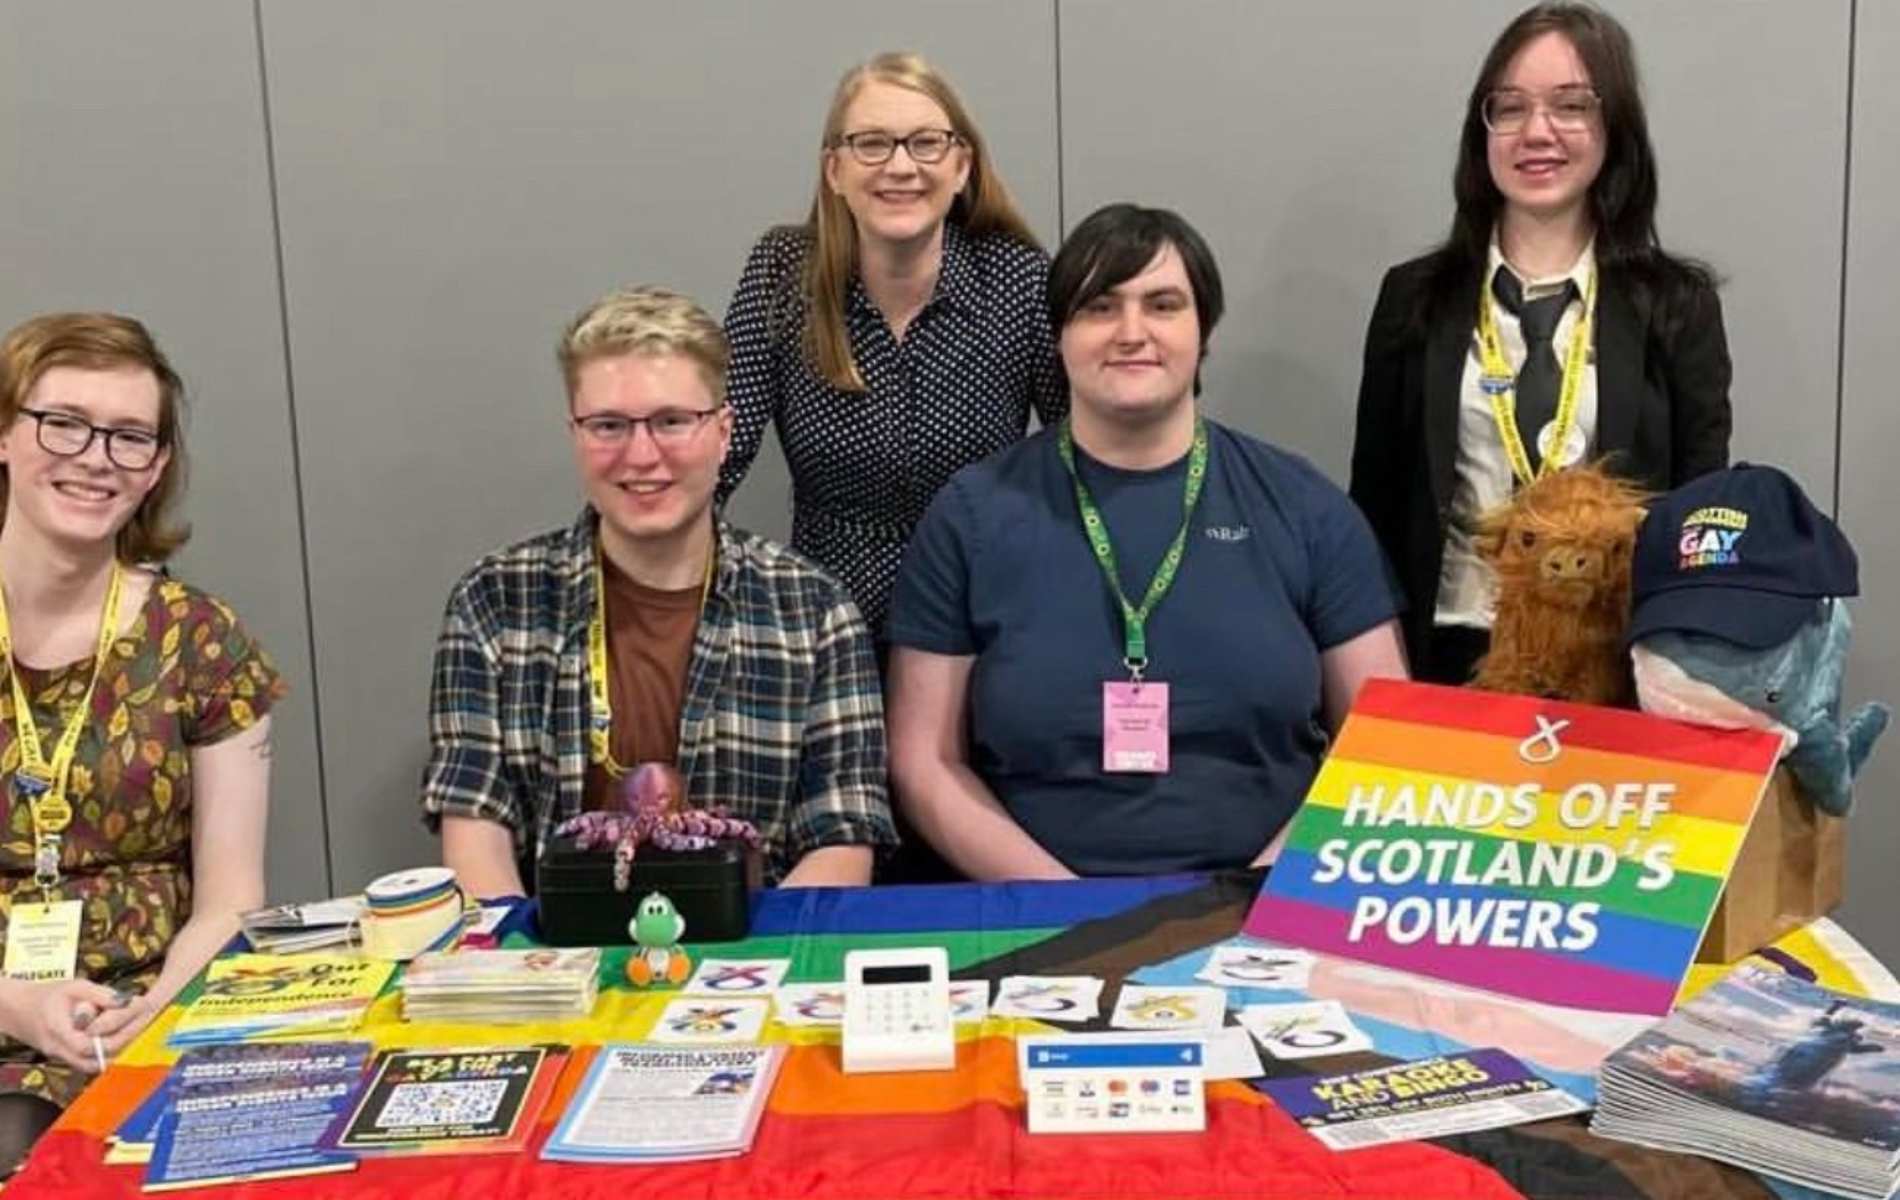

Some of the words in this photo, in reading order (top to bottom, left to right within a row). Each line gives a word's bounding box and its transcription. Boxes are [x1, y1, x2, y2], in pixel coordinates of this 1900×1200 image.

[1680, 529, 1743, 556] GAY
[1342, 783, 1541, 829] HANDS
[1560, 782, 1677, 829] OFF
[1312, 838, 1676, 891] SCOTLAND'S
[1348, 896, 1602, 950] POWERS
[1311, 1057, 1478, 1101] KARAOKE
